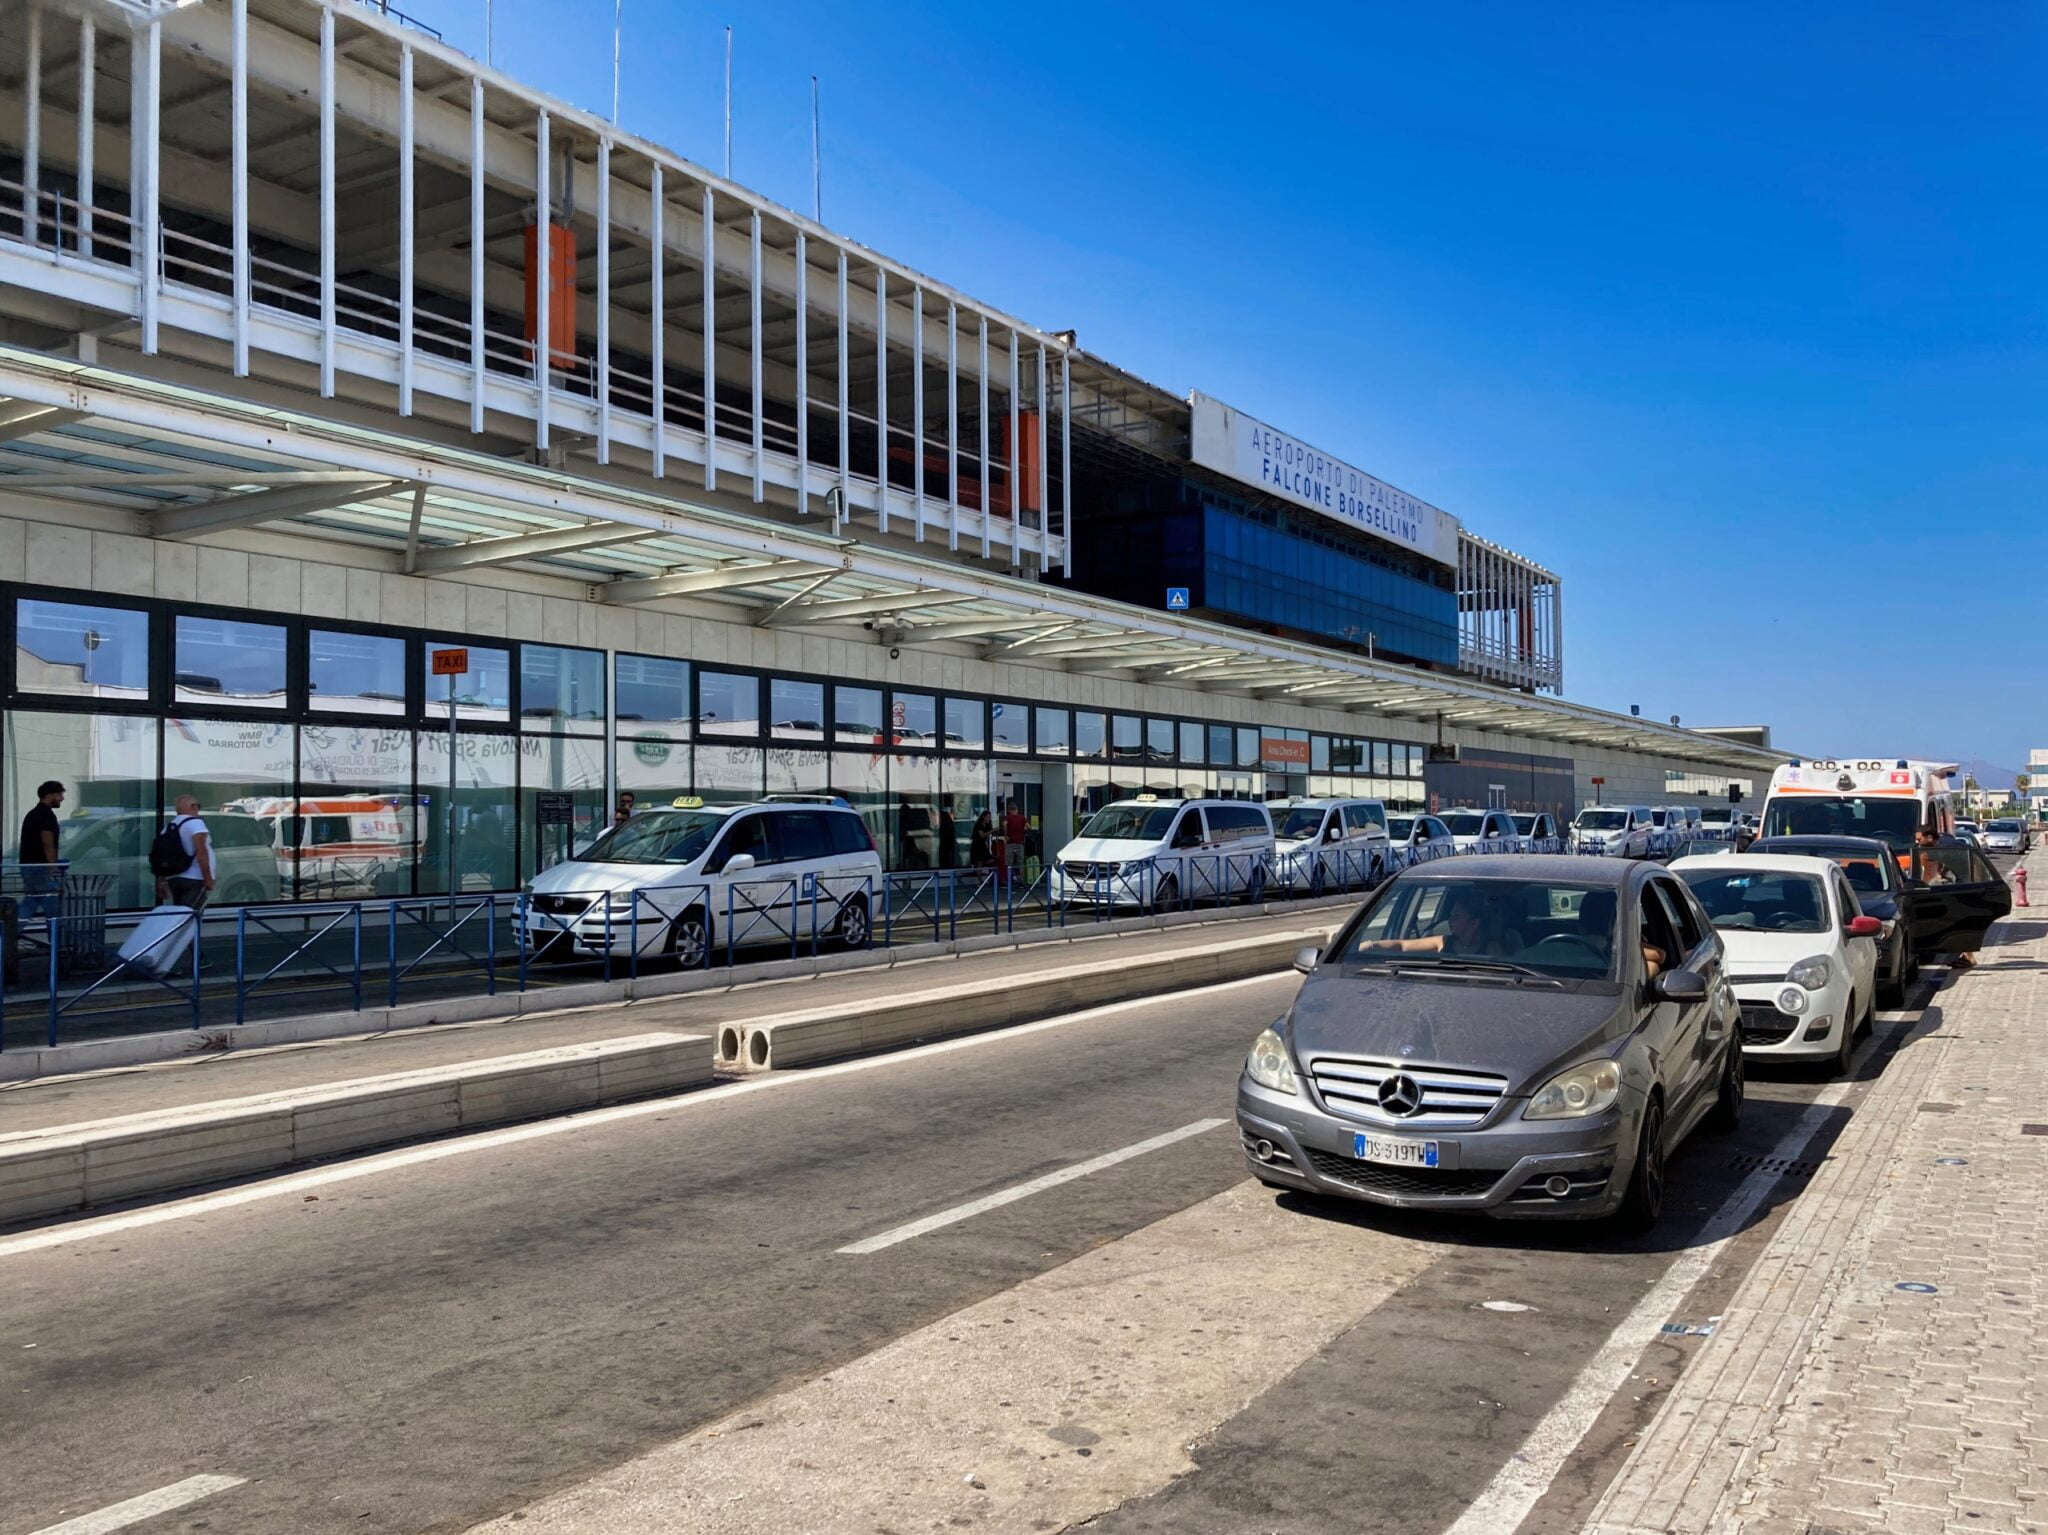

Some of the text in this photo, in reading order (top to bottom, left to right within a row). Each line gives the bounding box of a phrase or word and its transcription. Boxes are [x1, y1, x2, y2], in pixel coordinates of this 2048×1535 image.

[1252, 428, 1424, 525] AEROPORTO DI PALERMO
[1263, 458, 1417, 543] FALCONE BORSELLINO
[436, 655, 463, 668] TAXI
